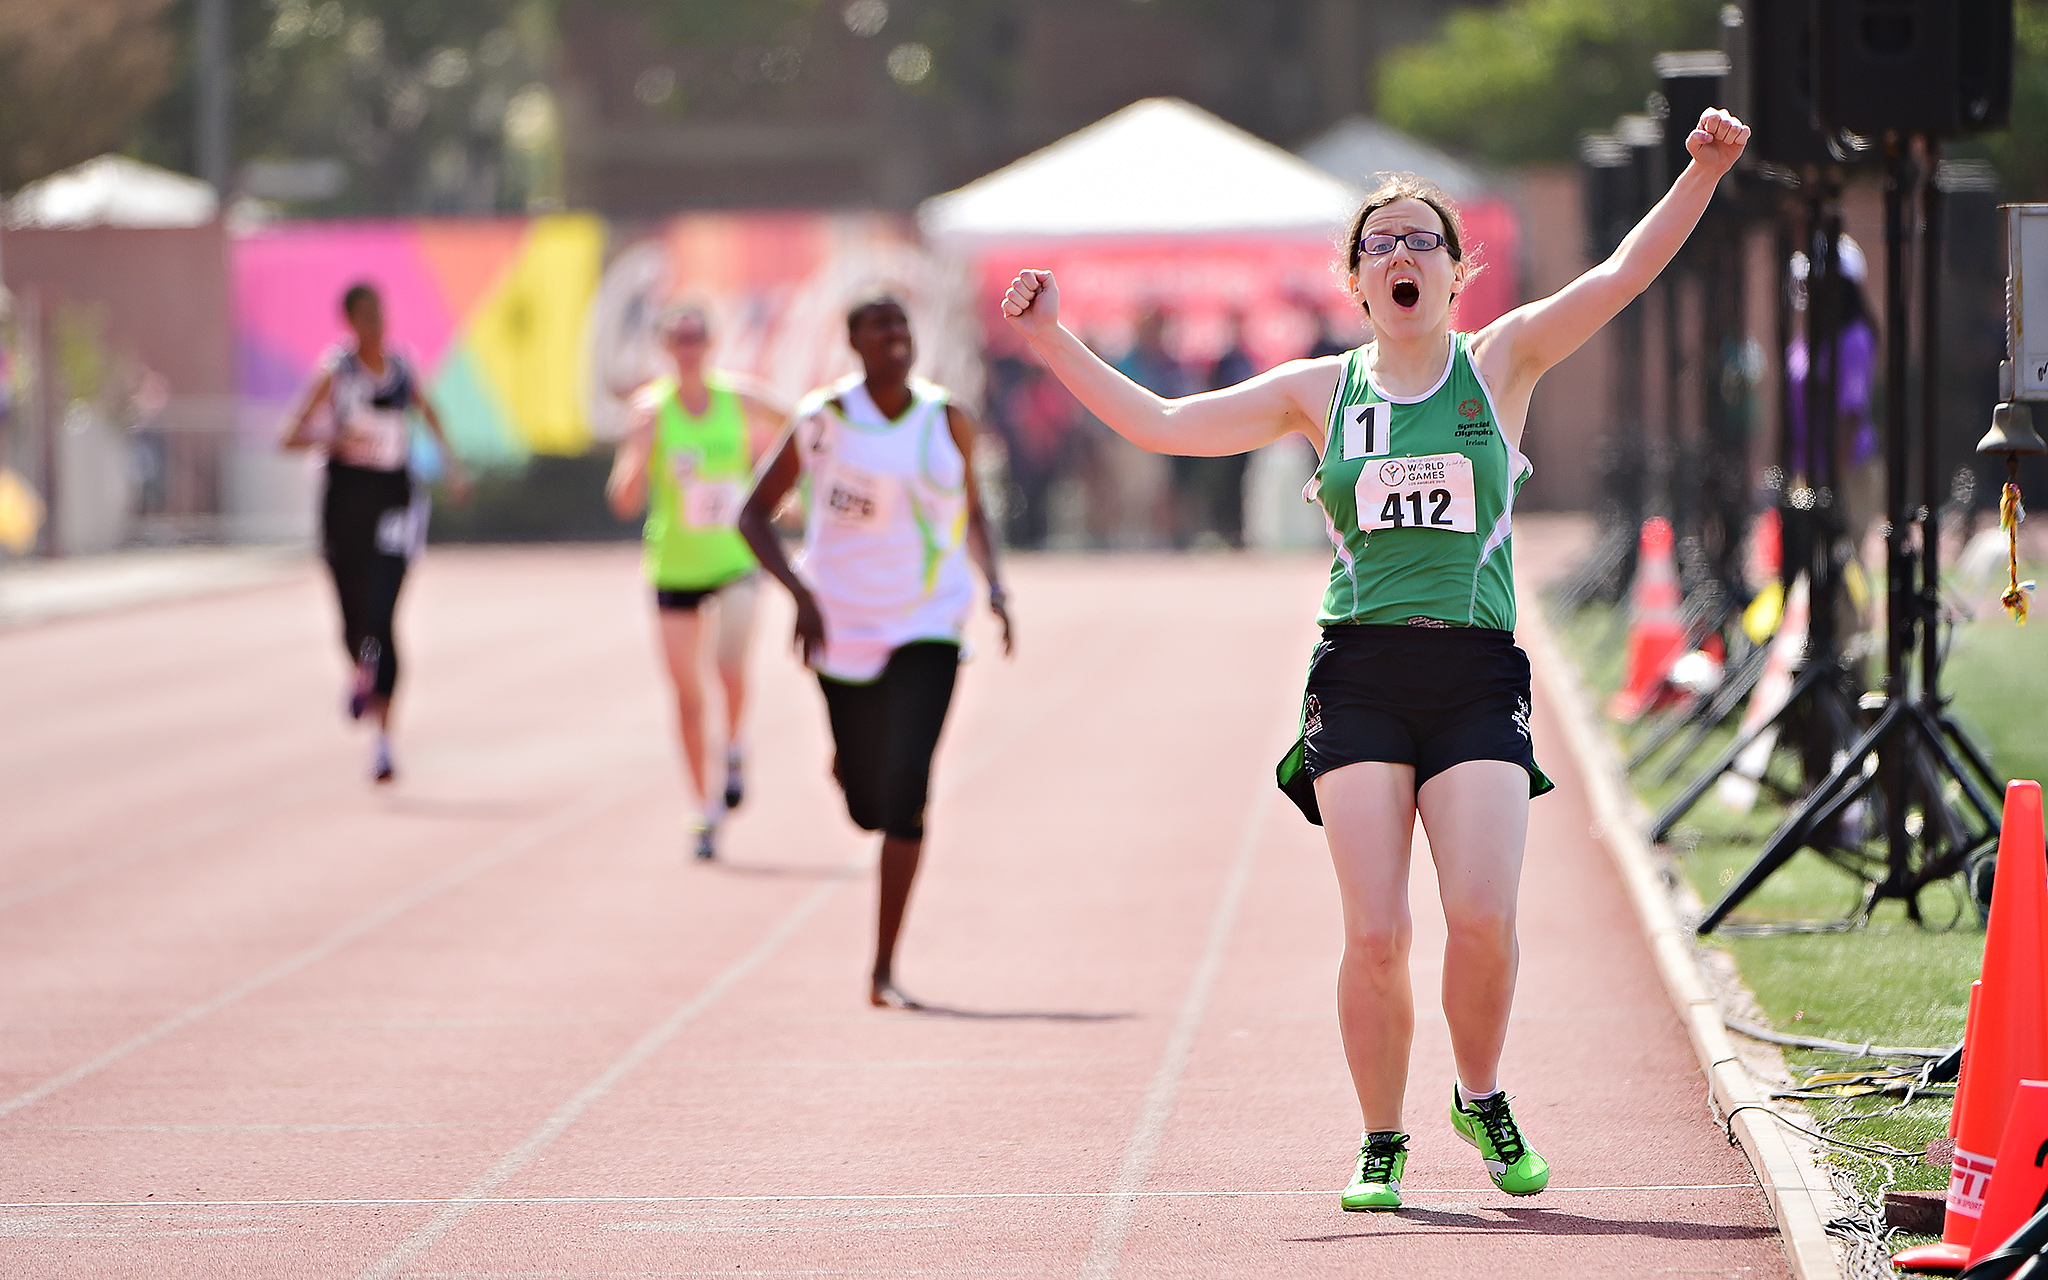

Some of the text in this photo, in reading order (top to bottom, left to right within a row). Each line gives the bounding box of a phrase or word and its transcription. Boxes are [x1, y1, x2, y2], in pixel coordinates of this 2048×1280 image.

[1356, 407, 1375, 453] 1
[1457, 421, 1490, 430] Special
[1455, 429, 1493, 437] Olympics
[1407, 462, 1444, 471] WORLD
[1408, 471, 1445, 481] GAMES
[1381, 488, 1453, 527] 412
